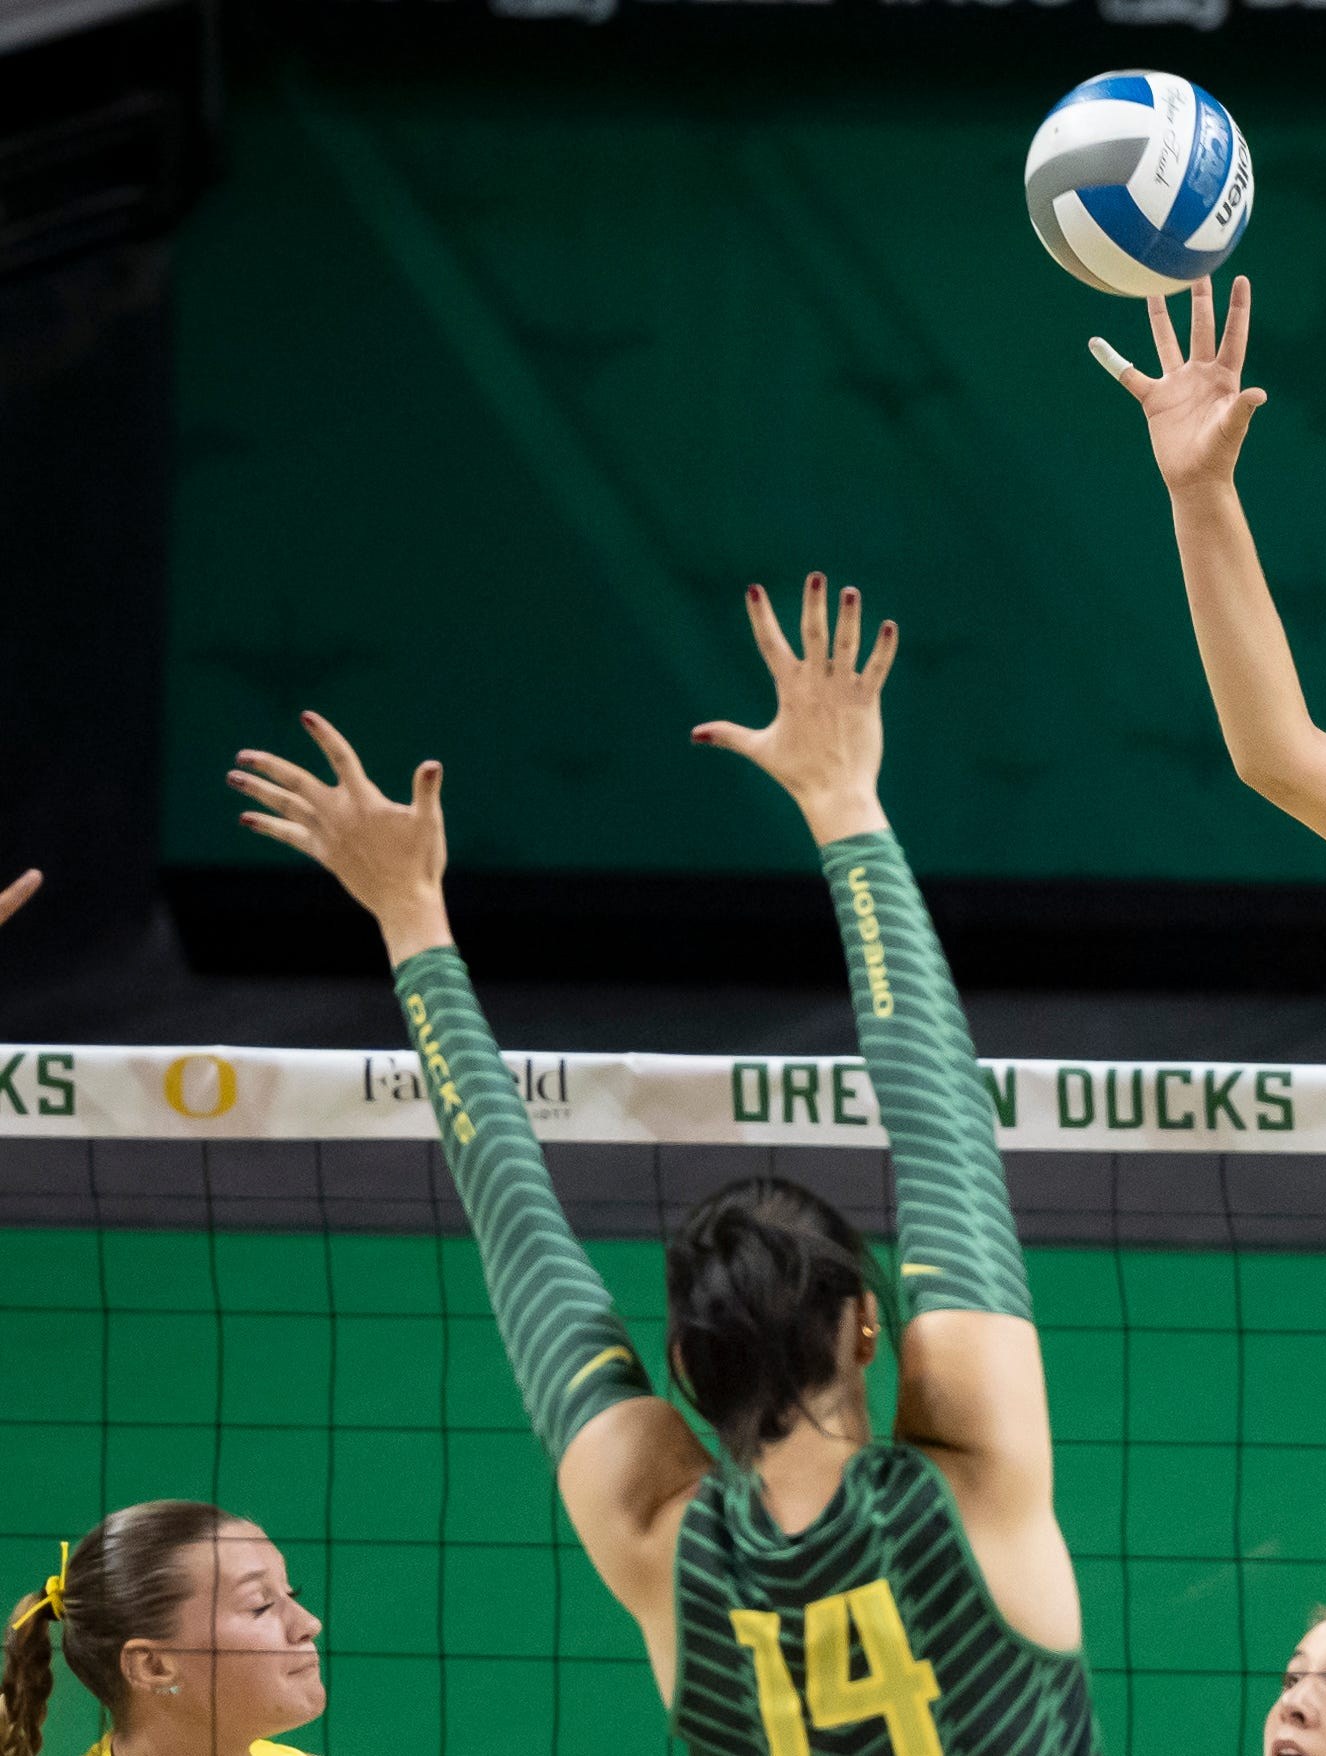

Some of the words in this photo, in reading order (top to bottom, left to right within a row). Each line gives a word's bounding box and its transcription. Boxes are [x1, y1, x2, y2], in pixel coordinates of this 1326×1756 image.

[1154, 129, 1182, 187] Touch
[406, 993, 477, 1146] DUCKS
[731, 1062, 1017, 1128] OREN
[1058, 1068, 1294, 1131] DUCKS
[729, 1578, 941, 1756] 14
